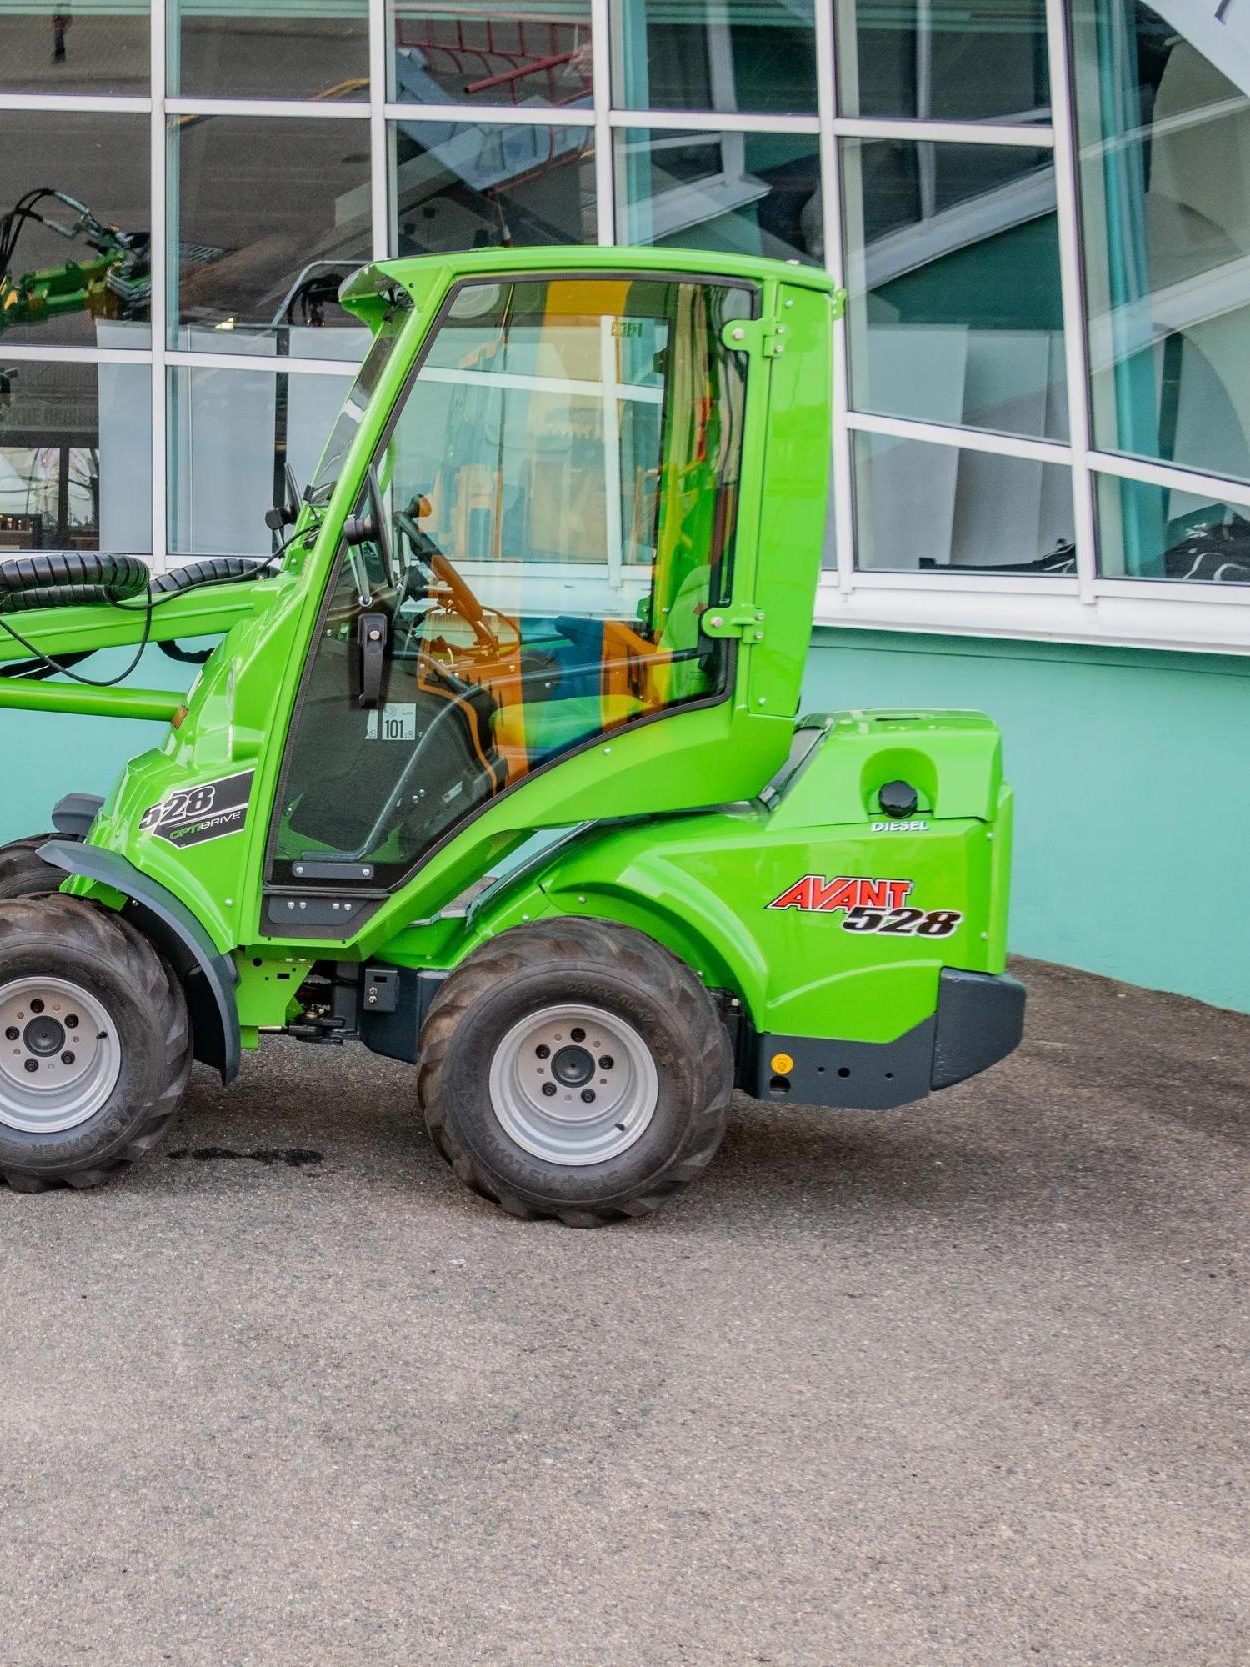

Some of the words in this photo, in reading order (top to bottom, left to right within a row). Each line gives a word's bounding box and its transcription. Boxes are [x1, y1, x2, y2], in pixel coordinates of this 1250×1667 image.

[384, 719, 404, 739] 101
[138, 786, 215, 829] 528
[871, 820, 929, 832] DIESEL
[765, 874, 913, 913] AVANT
[841, 905, 964, 939] 528
